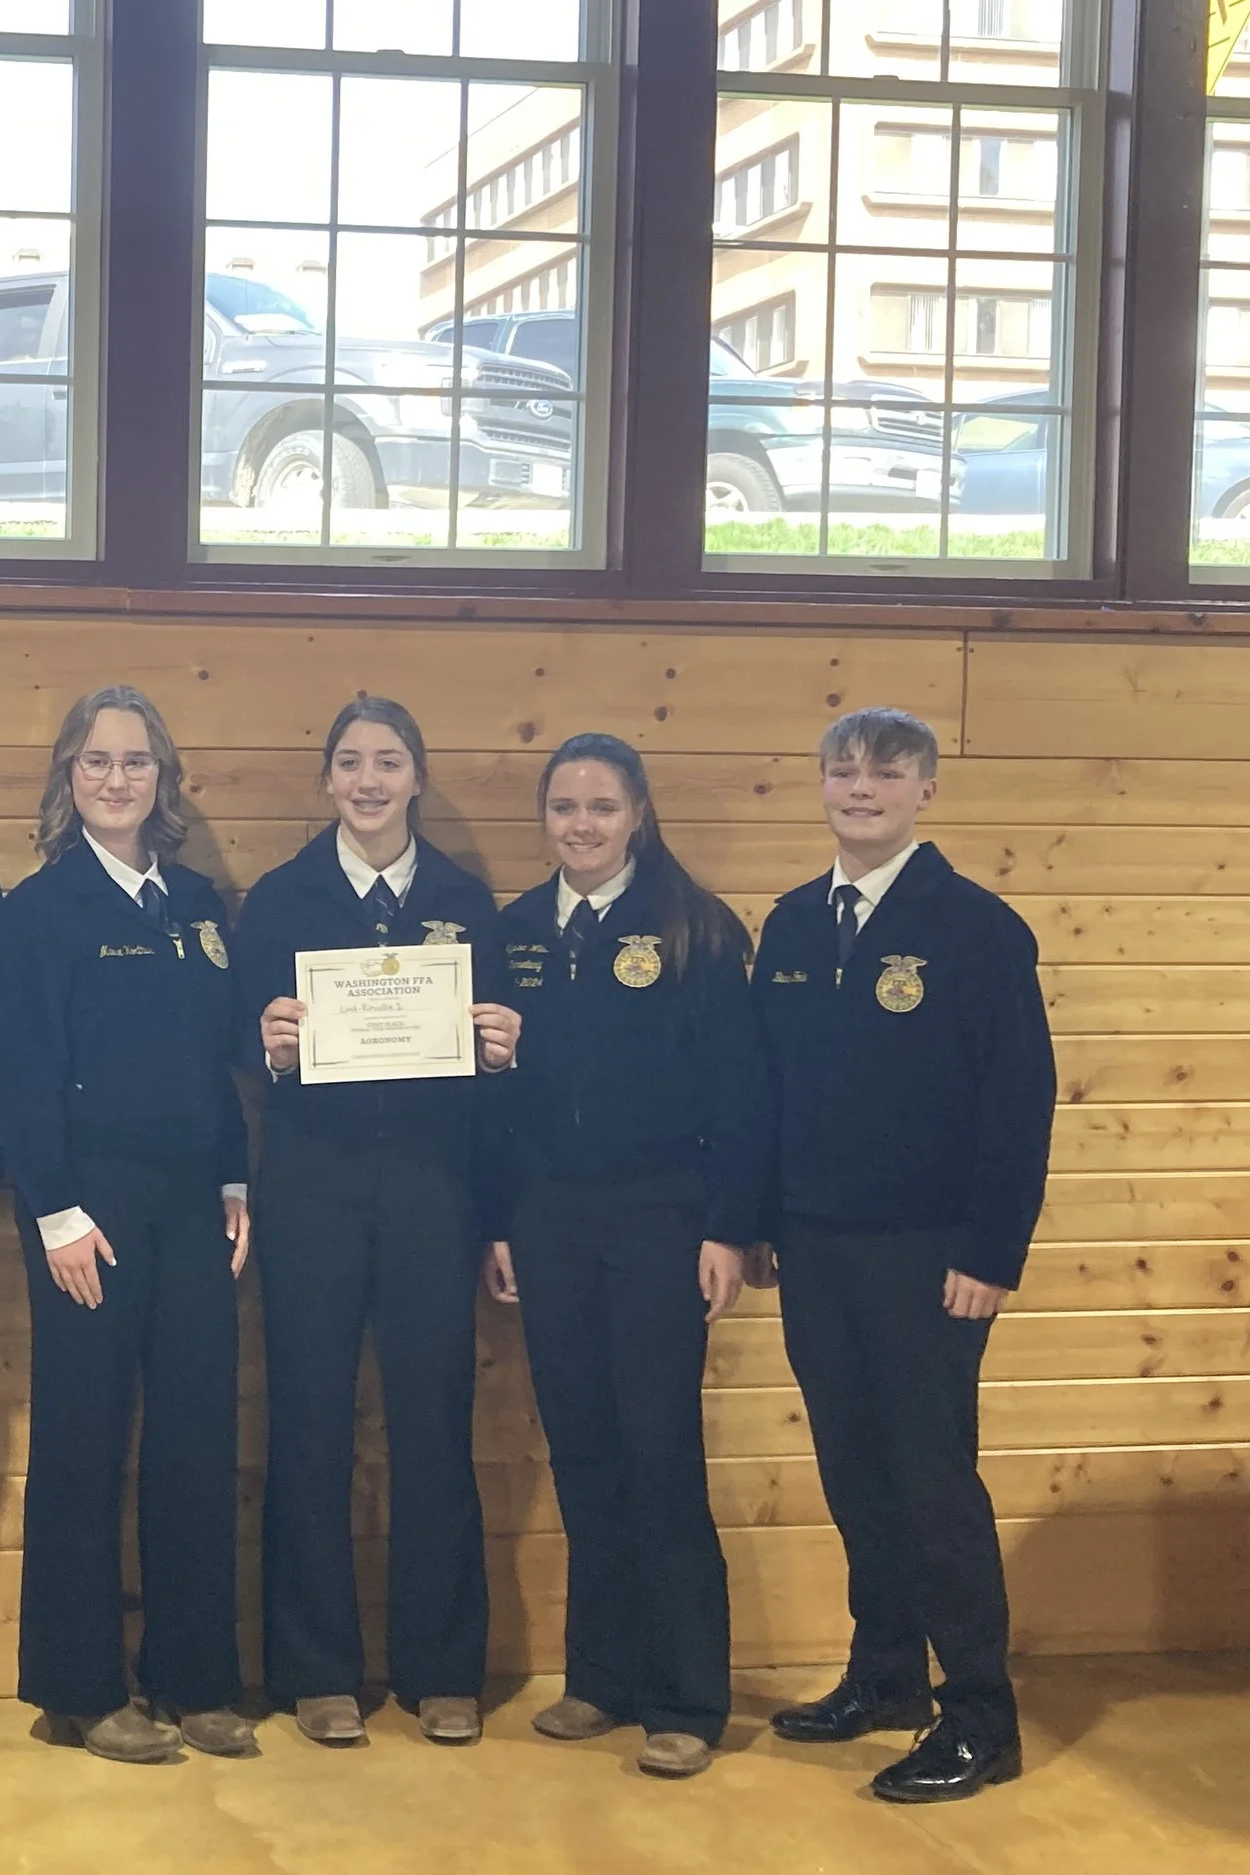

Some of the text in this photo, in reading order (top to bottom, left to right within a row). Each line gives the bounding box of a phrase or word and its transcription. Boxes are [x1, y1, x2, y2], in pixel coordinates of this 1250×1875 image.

[334, 976, 434, 988] WASHINGTON FFA
[347, 986, 421, 997] ASSOCIATION
[360, 1036, 412, 1044] AGRONOMY
